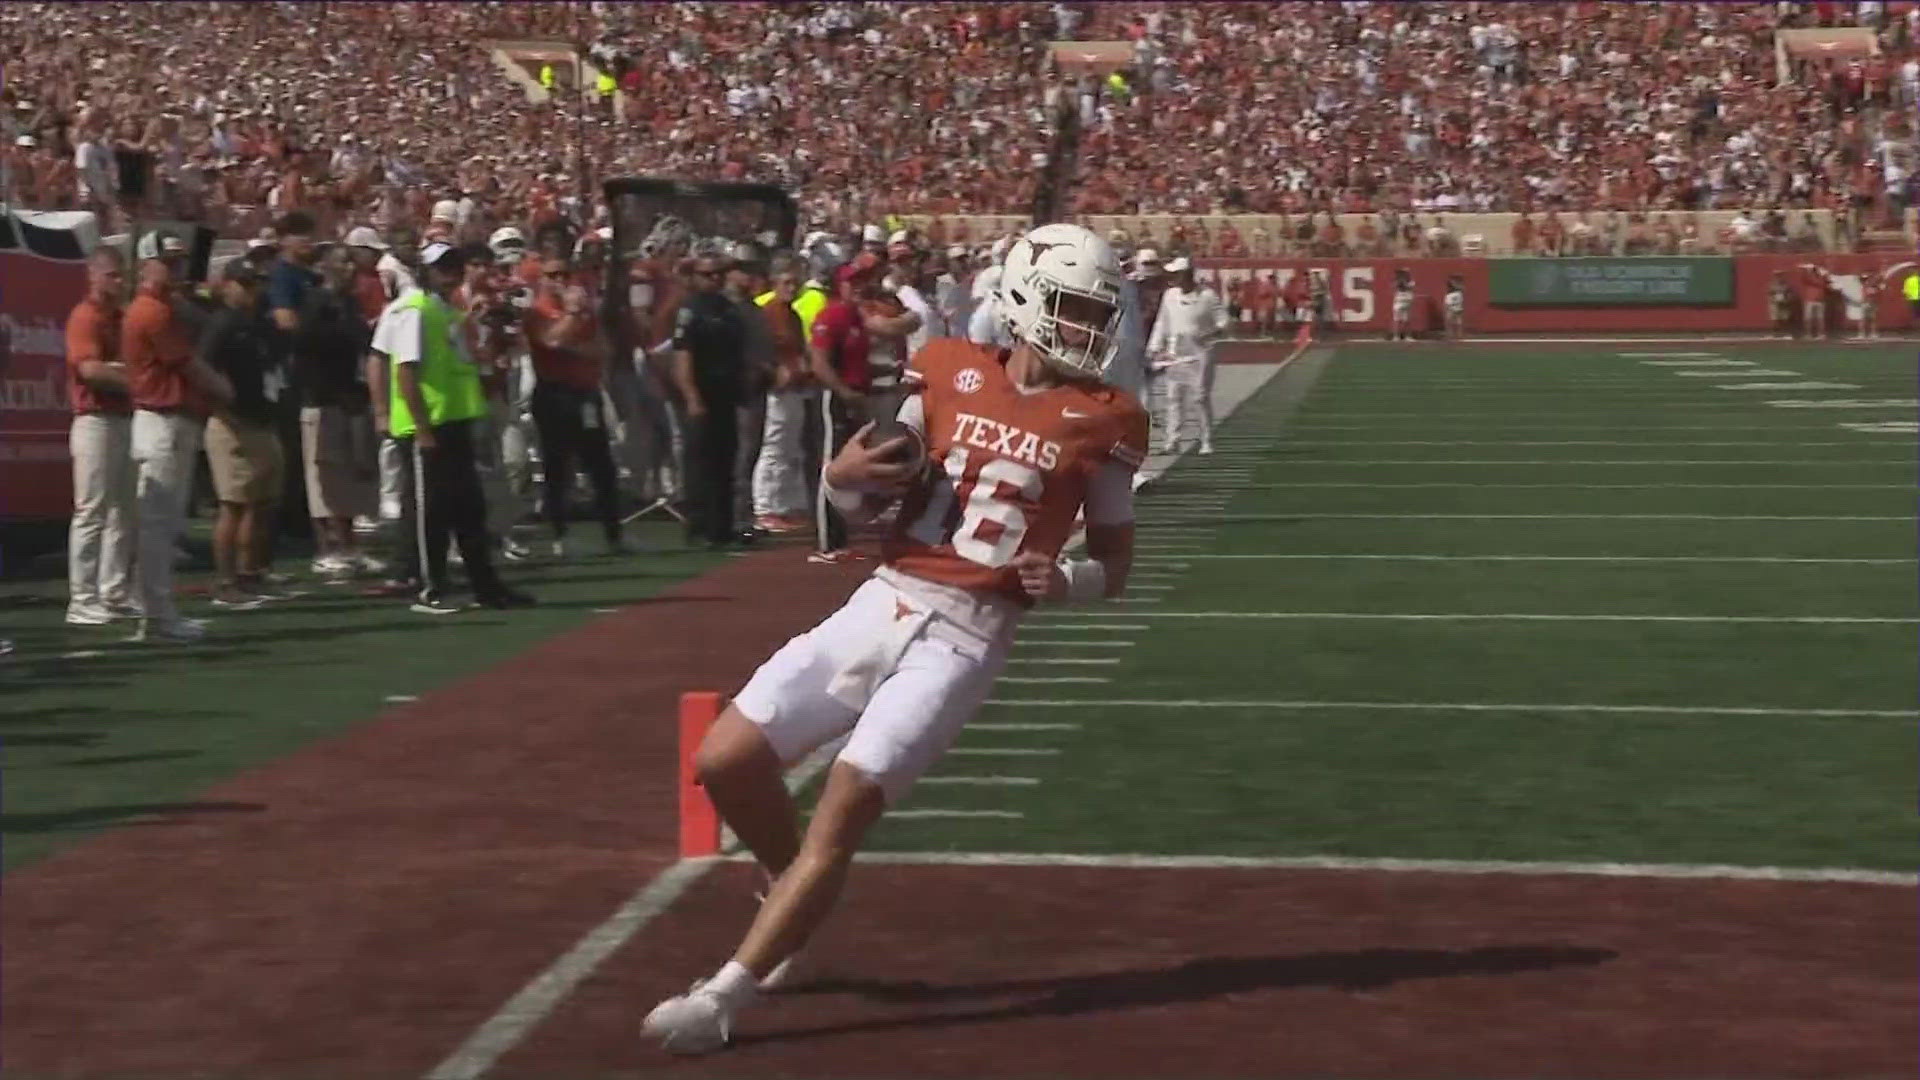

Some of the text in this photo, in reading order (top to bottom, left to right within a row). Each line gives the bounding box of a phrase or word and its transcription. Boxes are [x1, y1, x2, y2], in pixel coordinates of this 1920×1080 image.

[953, 368, 985, 393] SEC
[951, 412, 1061, 471] TEXAS
[907, 447, 1045, 569] 16
